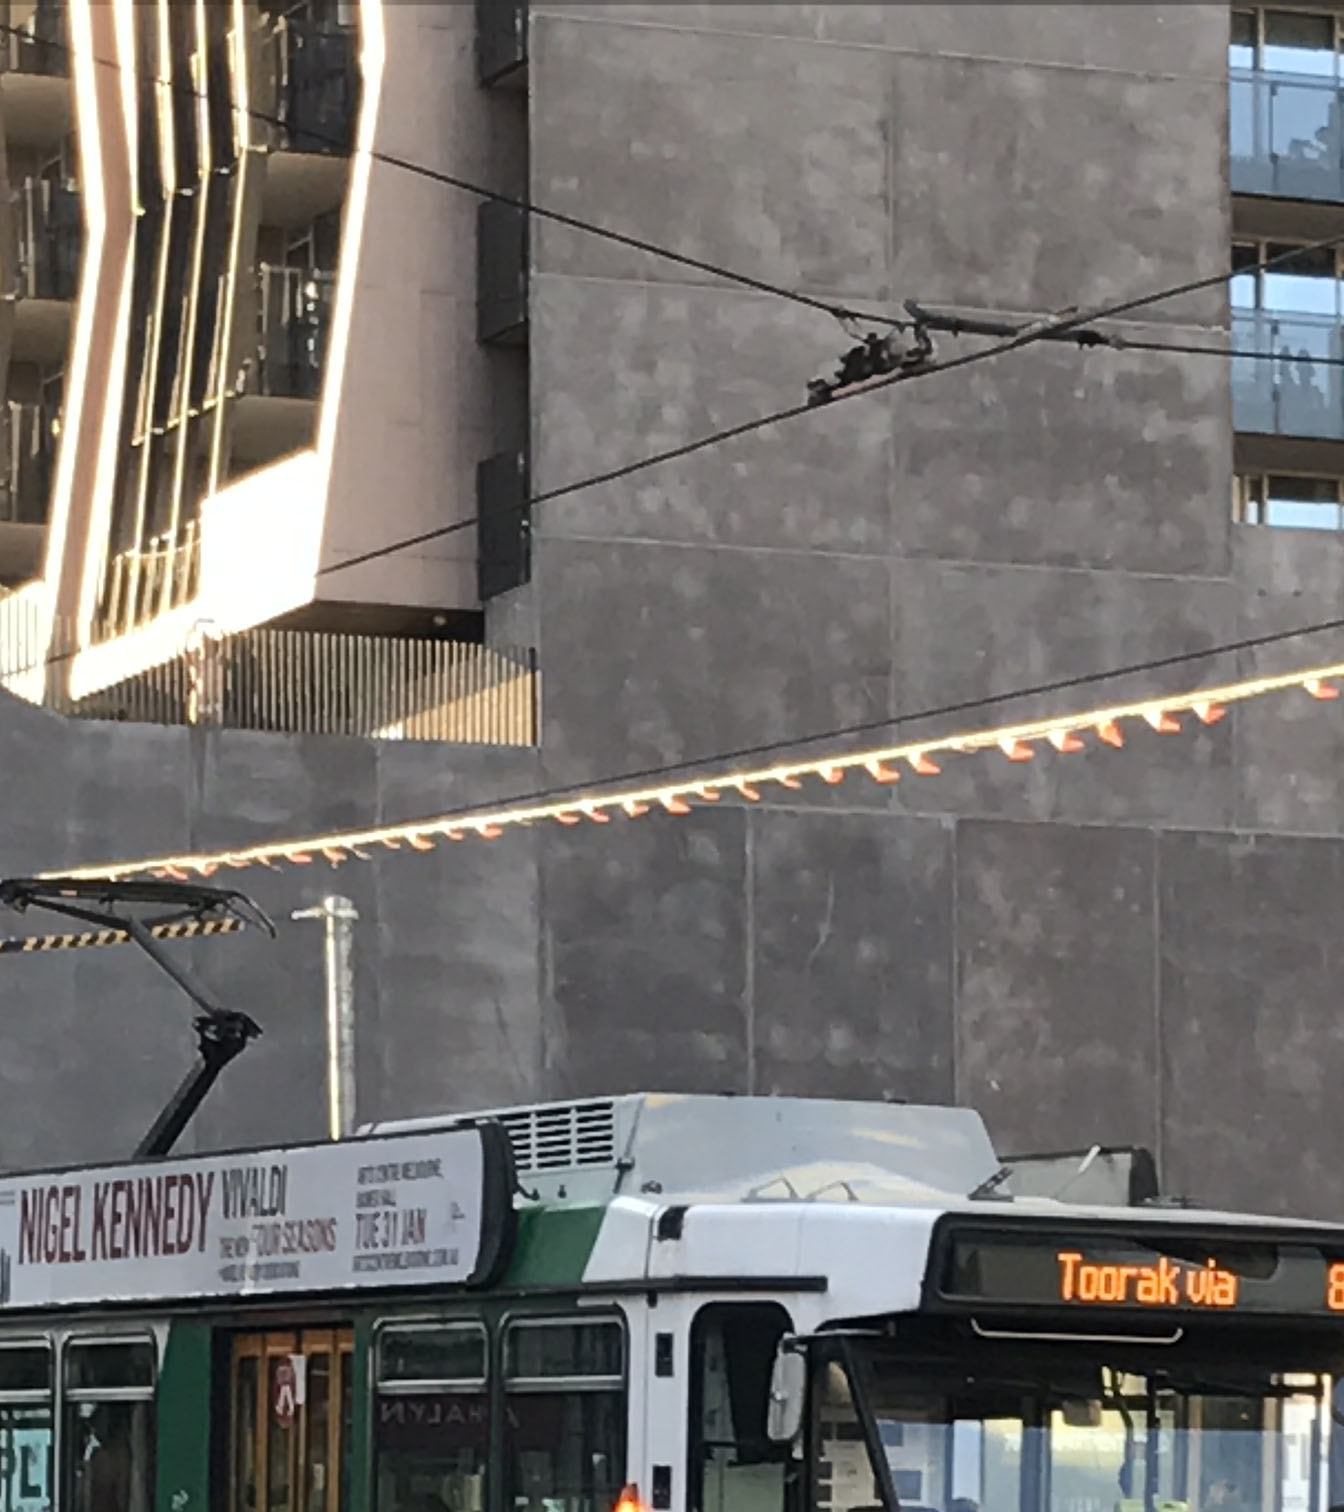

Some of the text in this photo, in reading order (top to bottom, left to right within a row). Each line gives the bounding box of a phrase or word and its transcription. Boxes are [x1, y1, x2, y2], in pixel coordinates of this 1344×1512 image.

[19, 1171, 215, 1264] NIGEL KENNEDY
[221, 1165, 288, 1219] VIVALDI
[1058, 1251, 1238, 1306] Toorak via
